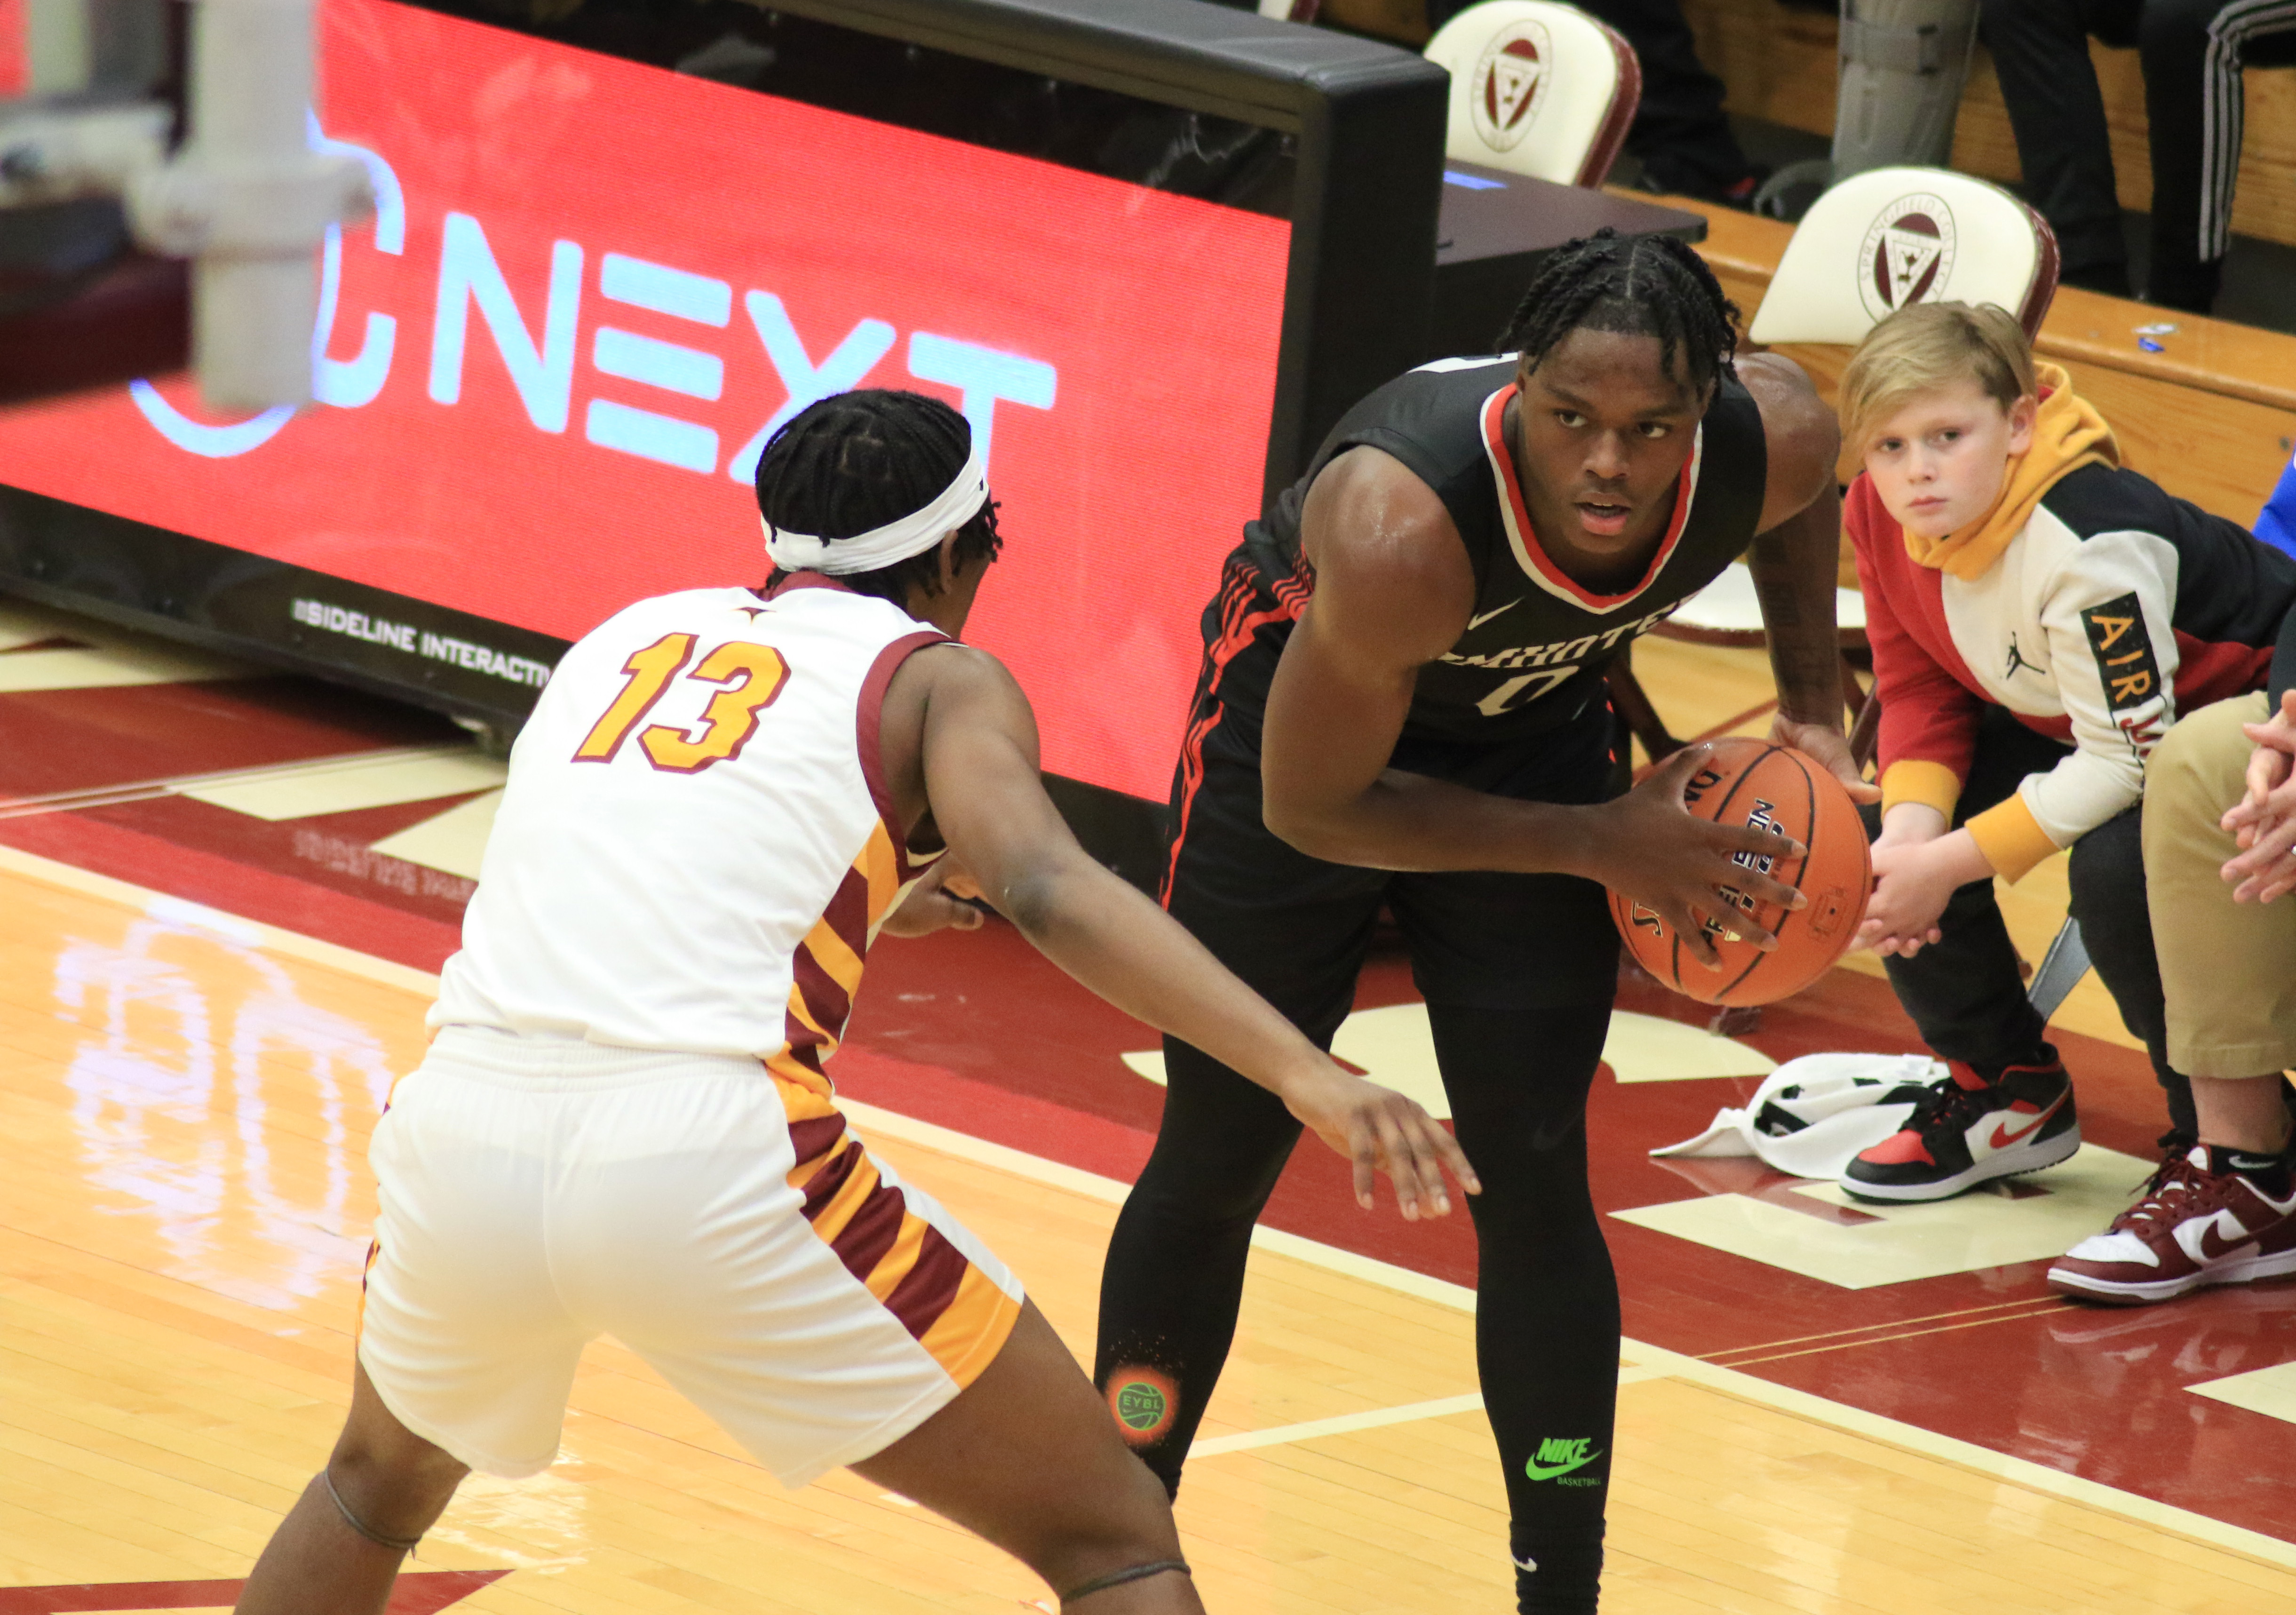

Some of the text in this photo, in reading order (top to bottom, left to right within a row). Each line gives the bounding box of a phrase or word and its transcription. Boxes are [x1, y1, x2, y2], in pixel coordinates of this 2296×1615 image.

[429, 212, 1057, 485] NEXT
[307, 601, 417, 652] SIDELINE
[2091, 614, 2150, 703] AIR
[570, 632, 791, 774] 13
[1476, 665, 1580, 716] 0
[1122, 1395, 1160, 1409] EYBL
[1536, 1437, 1591, 1464] NIKE
[1557, 1476, 1601, 1487] BASKETBALL
